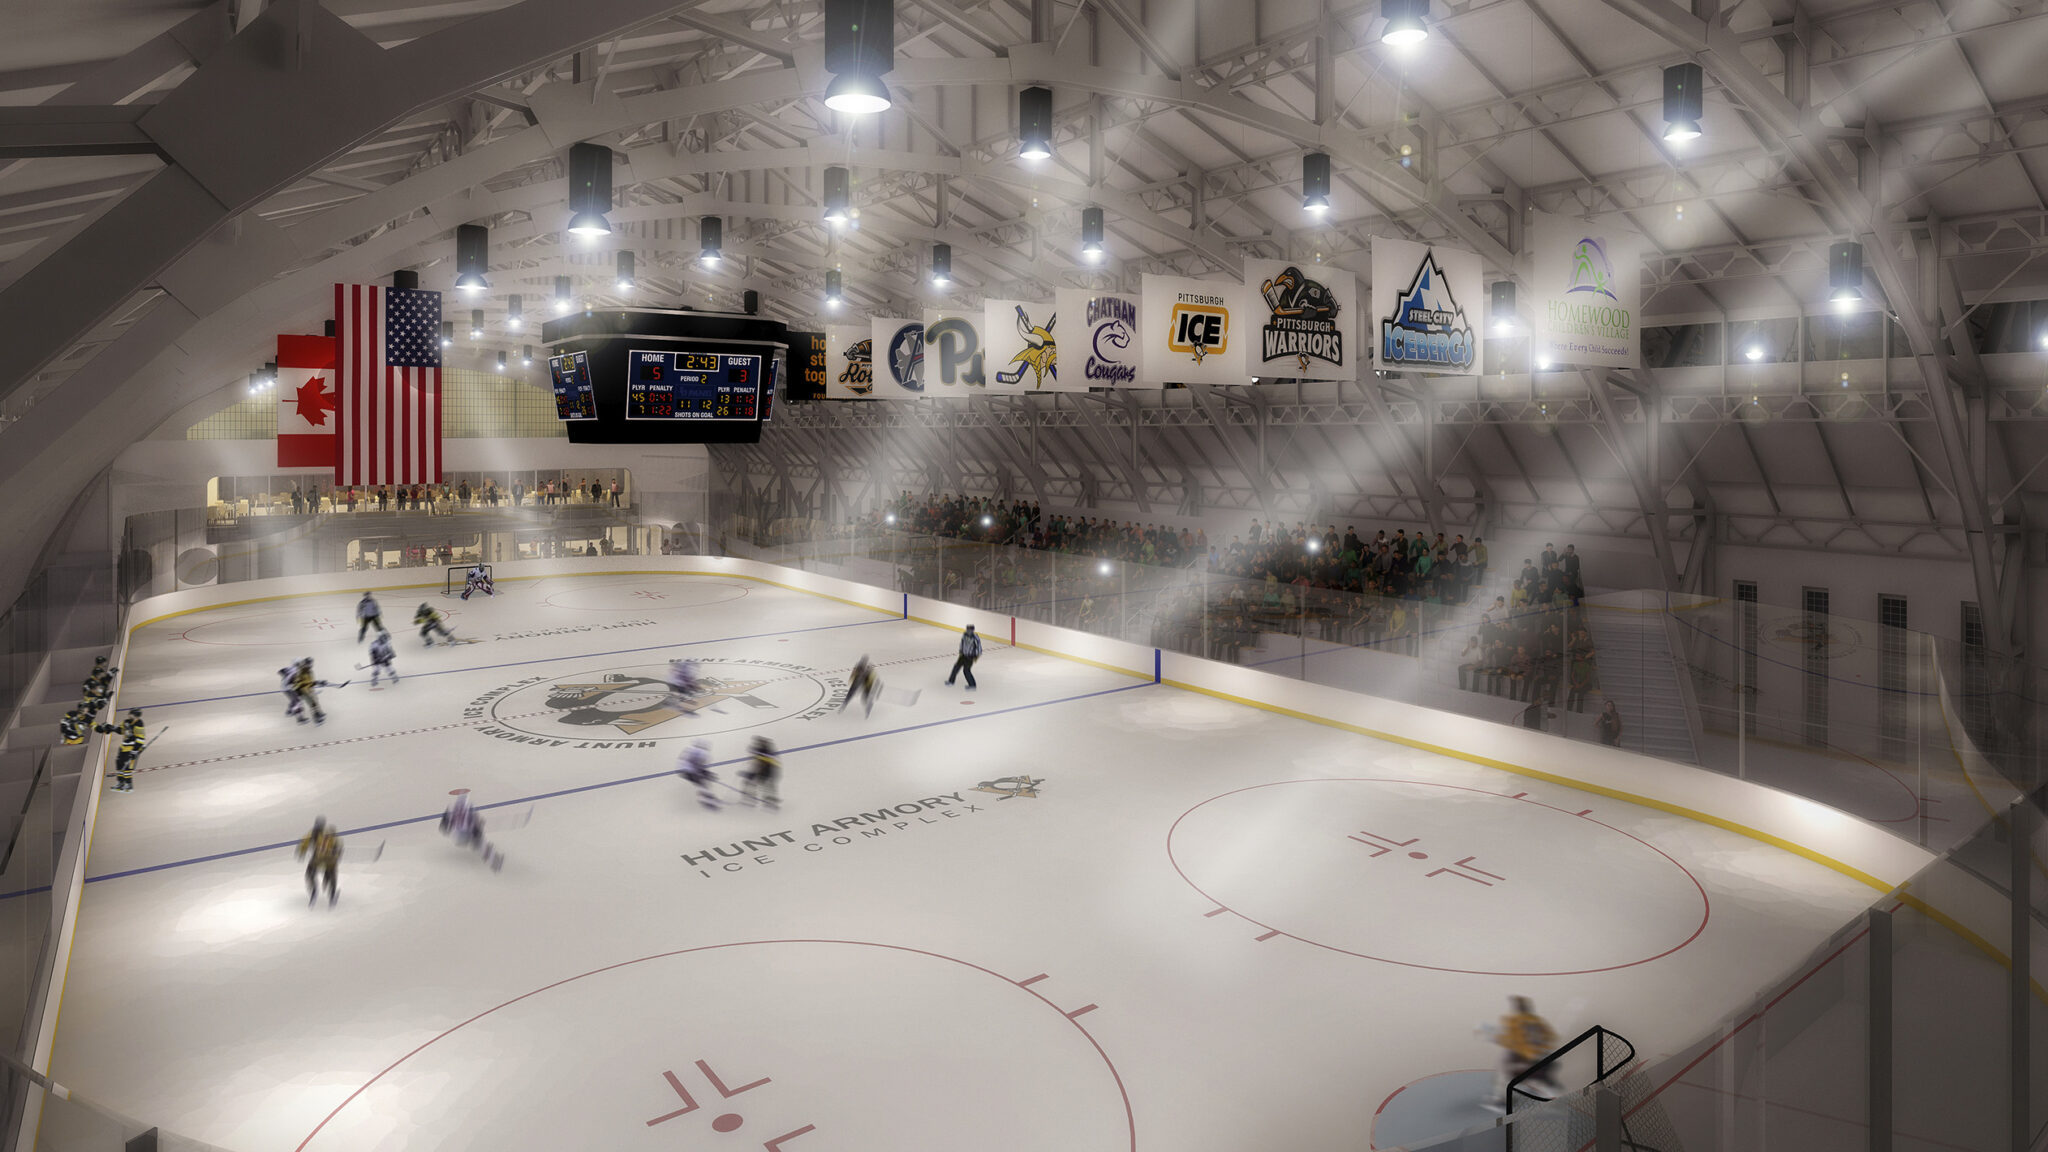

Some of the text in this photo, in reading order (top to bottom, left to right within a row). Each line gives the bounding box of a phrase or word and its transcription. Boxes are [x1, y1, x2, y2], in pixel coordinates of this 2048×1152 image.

[1178, 292, 1224, 306] PITTSBURGH
[1086, 296, 1136, 333] CHATHAM
[1409, 309, 1453, 325] STEEL CITY
[1547, 299, 1630, 329] HOMEWOOD
[1177, 313, 1222, 345] ICE
[1277, 318, 1331, 332] PITTSBURGH
[1597, 324, 1630, 340] VILLAGE
[1264, 329, 1341, 363] WARRIORS
[1384, 322, 1473, 366] ICEBERGS
[1569, 342, 1588, 354] Every
[1601, 346, 1629, 356] Succeeds!
[641, 353, 665, 362] HOME
[686, 355, 717, 369] 2:43
[728, 357, 752, 366] GUEST
[652, 366, 661, 380] 5
[739, 369, 748, 382] 3
[1084, 355, 1137, 386] Cougars
[700, 374, 708, 384] 2
[649, 384, 674, 392] PENALTY
[632, 392, 646, 403] 45
[649, 392, 673, 403] 0:47
[680, 399, 691, 408] 11
[720, 394, 755, 404] 13 1:12
[639, 404, 673, 416] 7 1:22
[702, 400, 713, 410] 12
[716, 406, 754, 416] 26 1:18
[733, 658, 817, 673] ARMORY
[469, 675, 550, 707] COMPLEX
[473, 724, 657, 750] HUNT ARMORY
[680, 791, 967, 867] HUNT ARMORY
[699, 803, 985, 879] ICE COMPLEX
